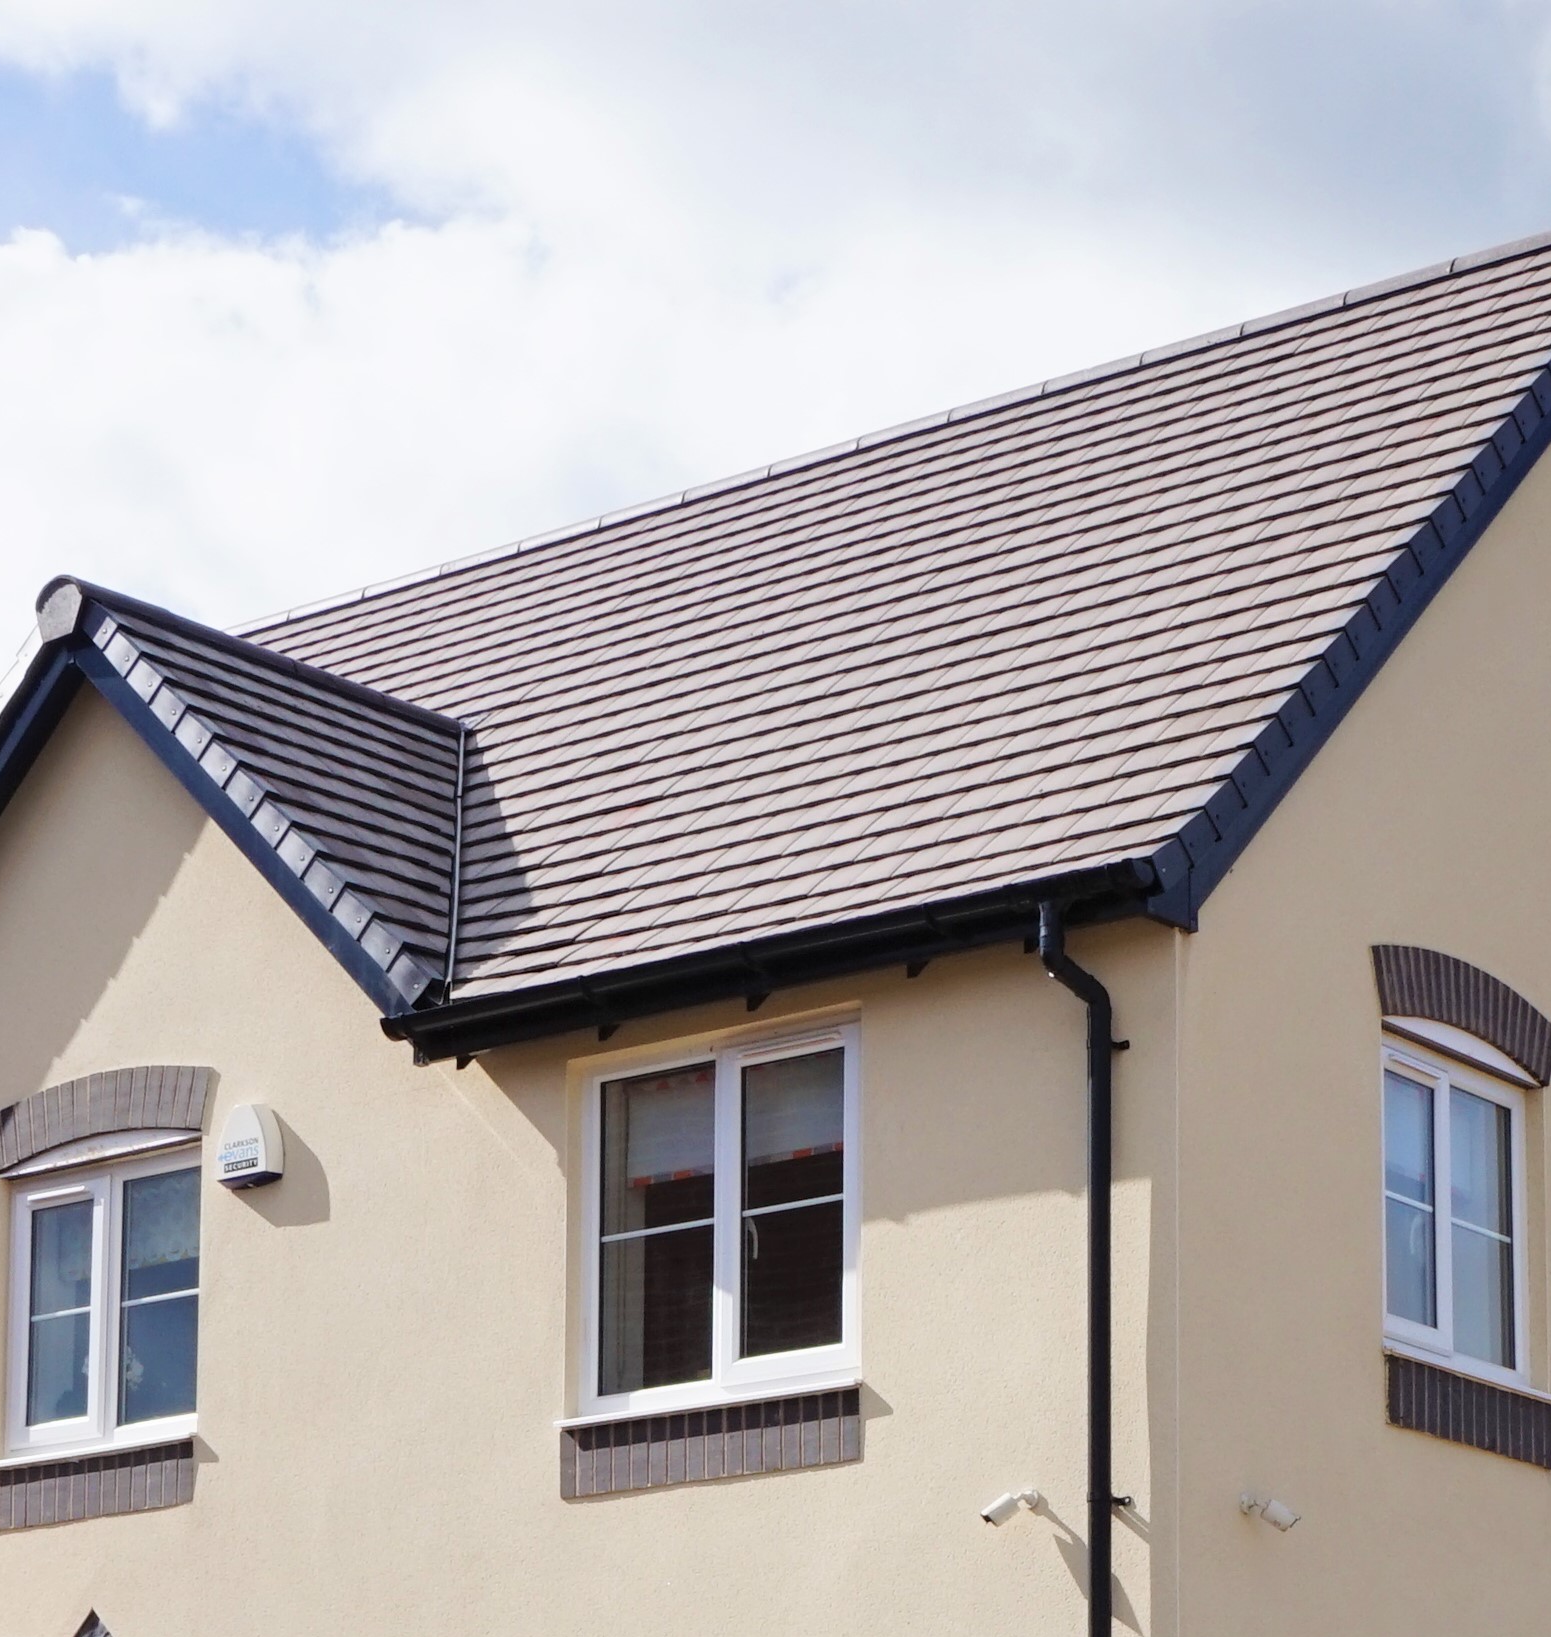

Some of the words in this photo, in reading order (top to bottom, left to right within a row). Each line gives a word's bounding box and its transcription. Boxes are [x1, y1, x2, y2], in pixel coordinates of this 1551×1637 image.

[224, 1138, 258, 1150] CLARKSON
[224, 1146, 258, 1161] evans
[225, 1160, 257, 1172] SECURITY
